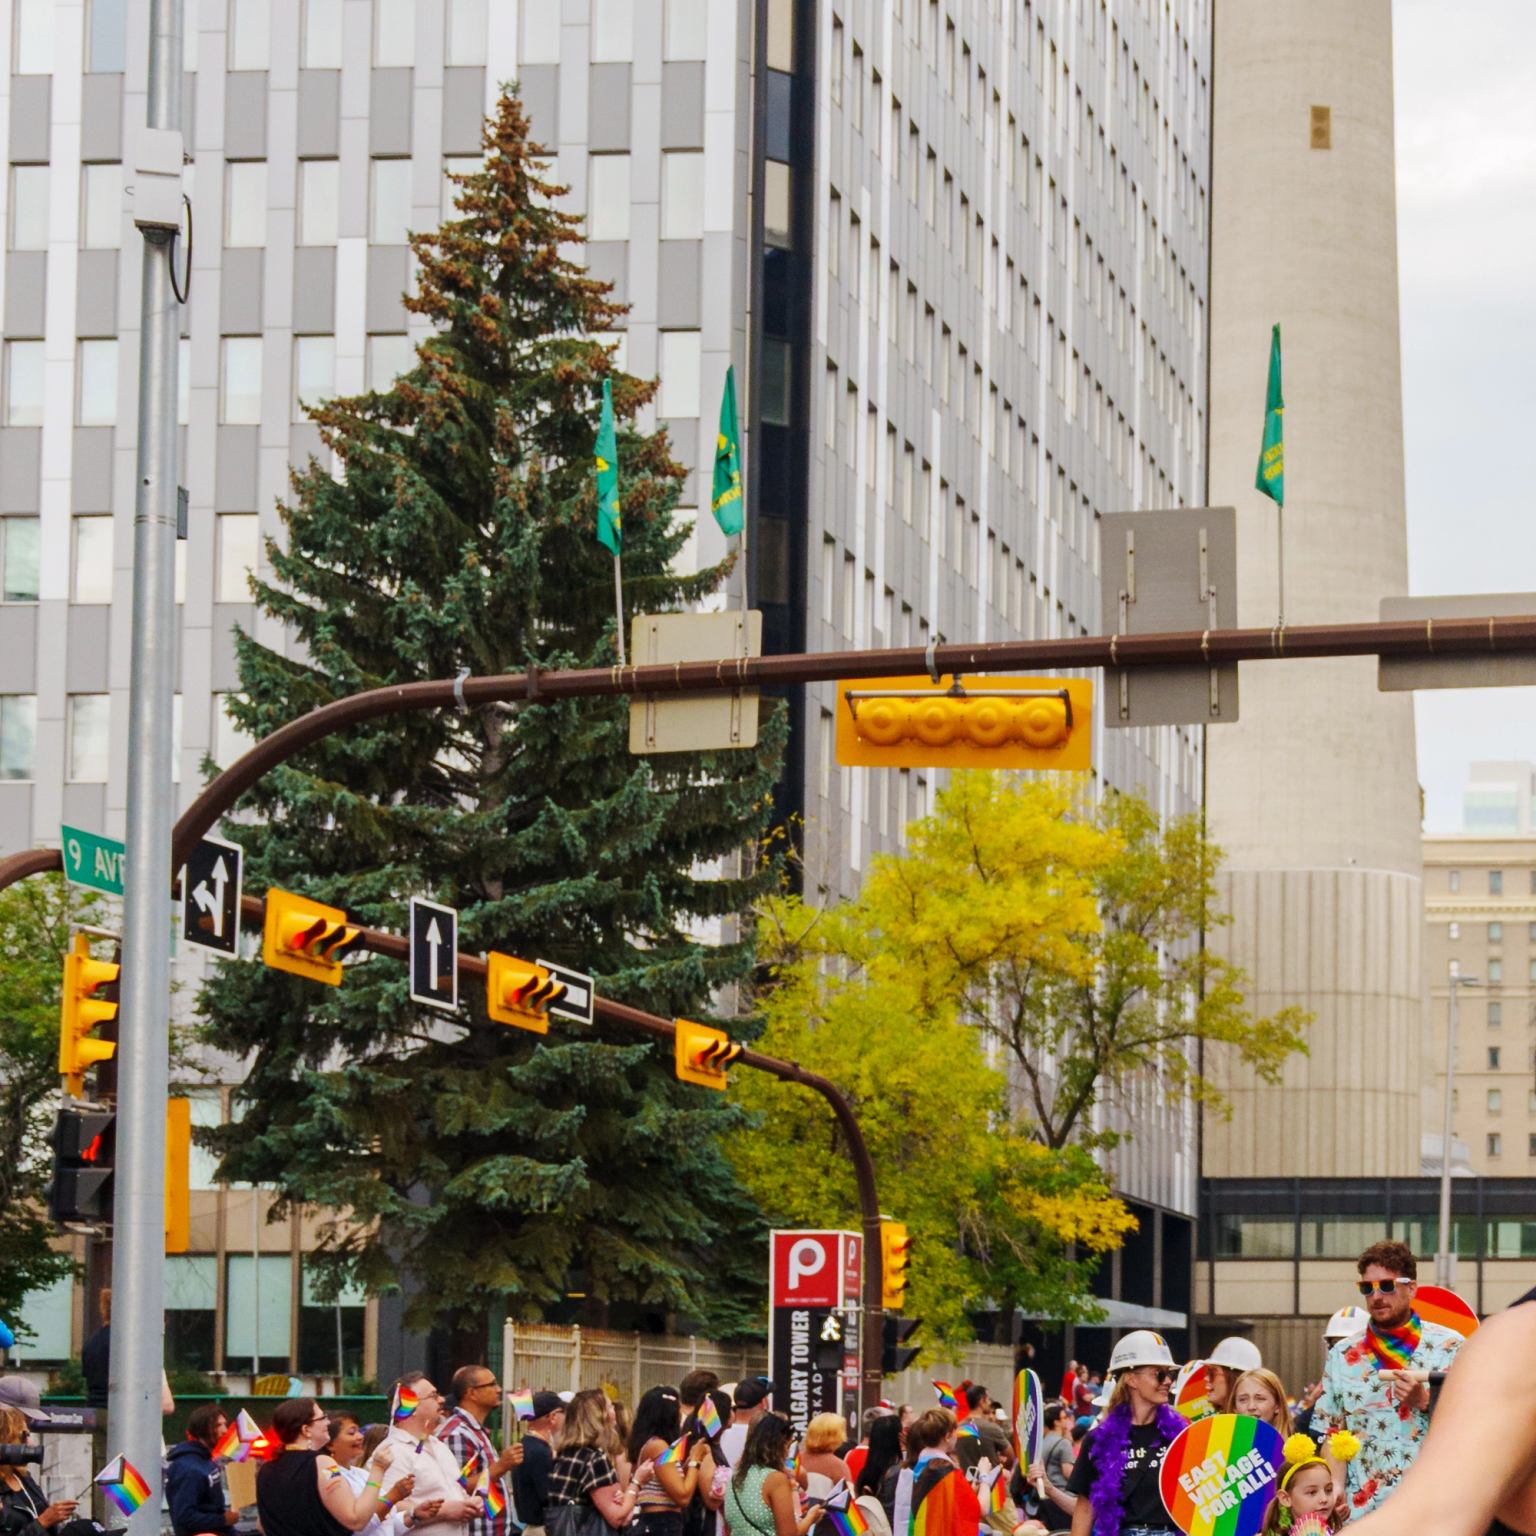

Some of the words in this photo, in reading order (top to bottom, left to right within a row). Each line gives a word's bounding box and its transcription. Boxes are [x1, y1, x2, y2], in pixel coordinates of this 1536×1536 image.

[68, 839, 82, 871] 9
[788, 1238, 826, 1290] P
[791, 1310, 809, 1365] TOWER
[790, 1369, 809, 1437] ALGARY
[1178, 1450, 1226, 1493] EAST
[1187, 1447, 1265, 1506] VILLAGE
[1199, 1490, 1240, 1525] FOR
[1237, 1461, 1277, 1500] ALL!
